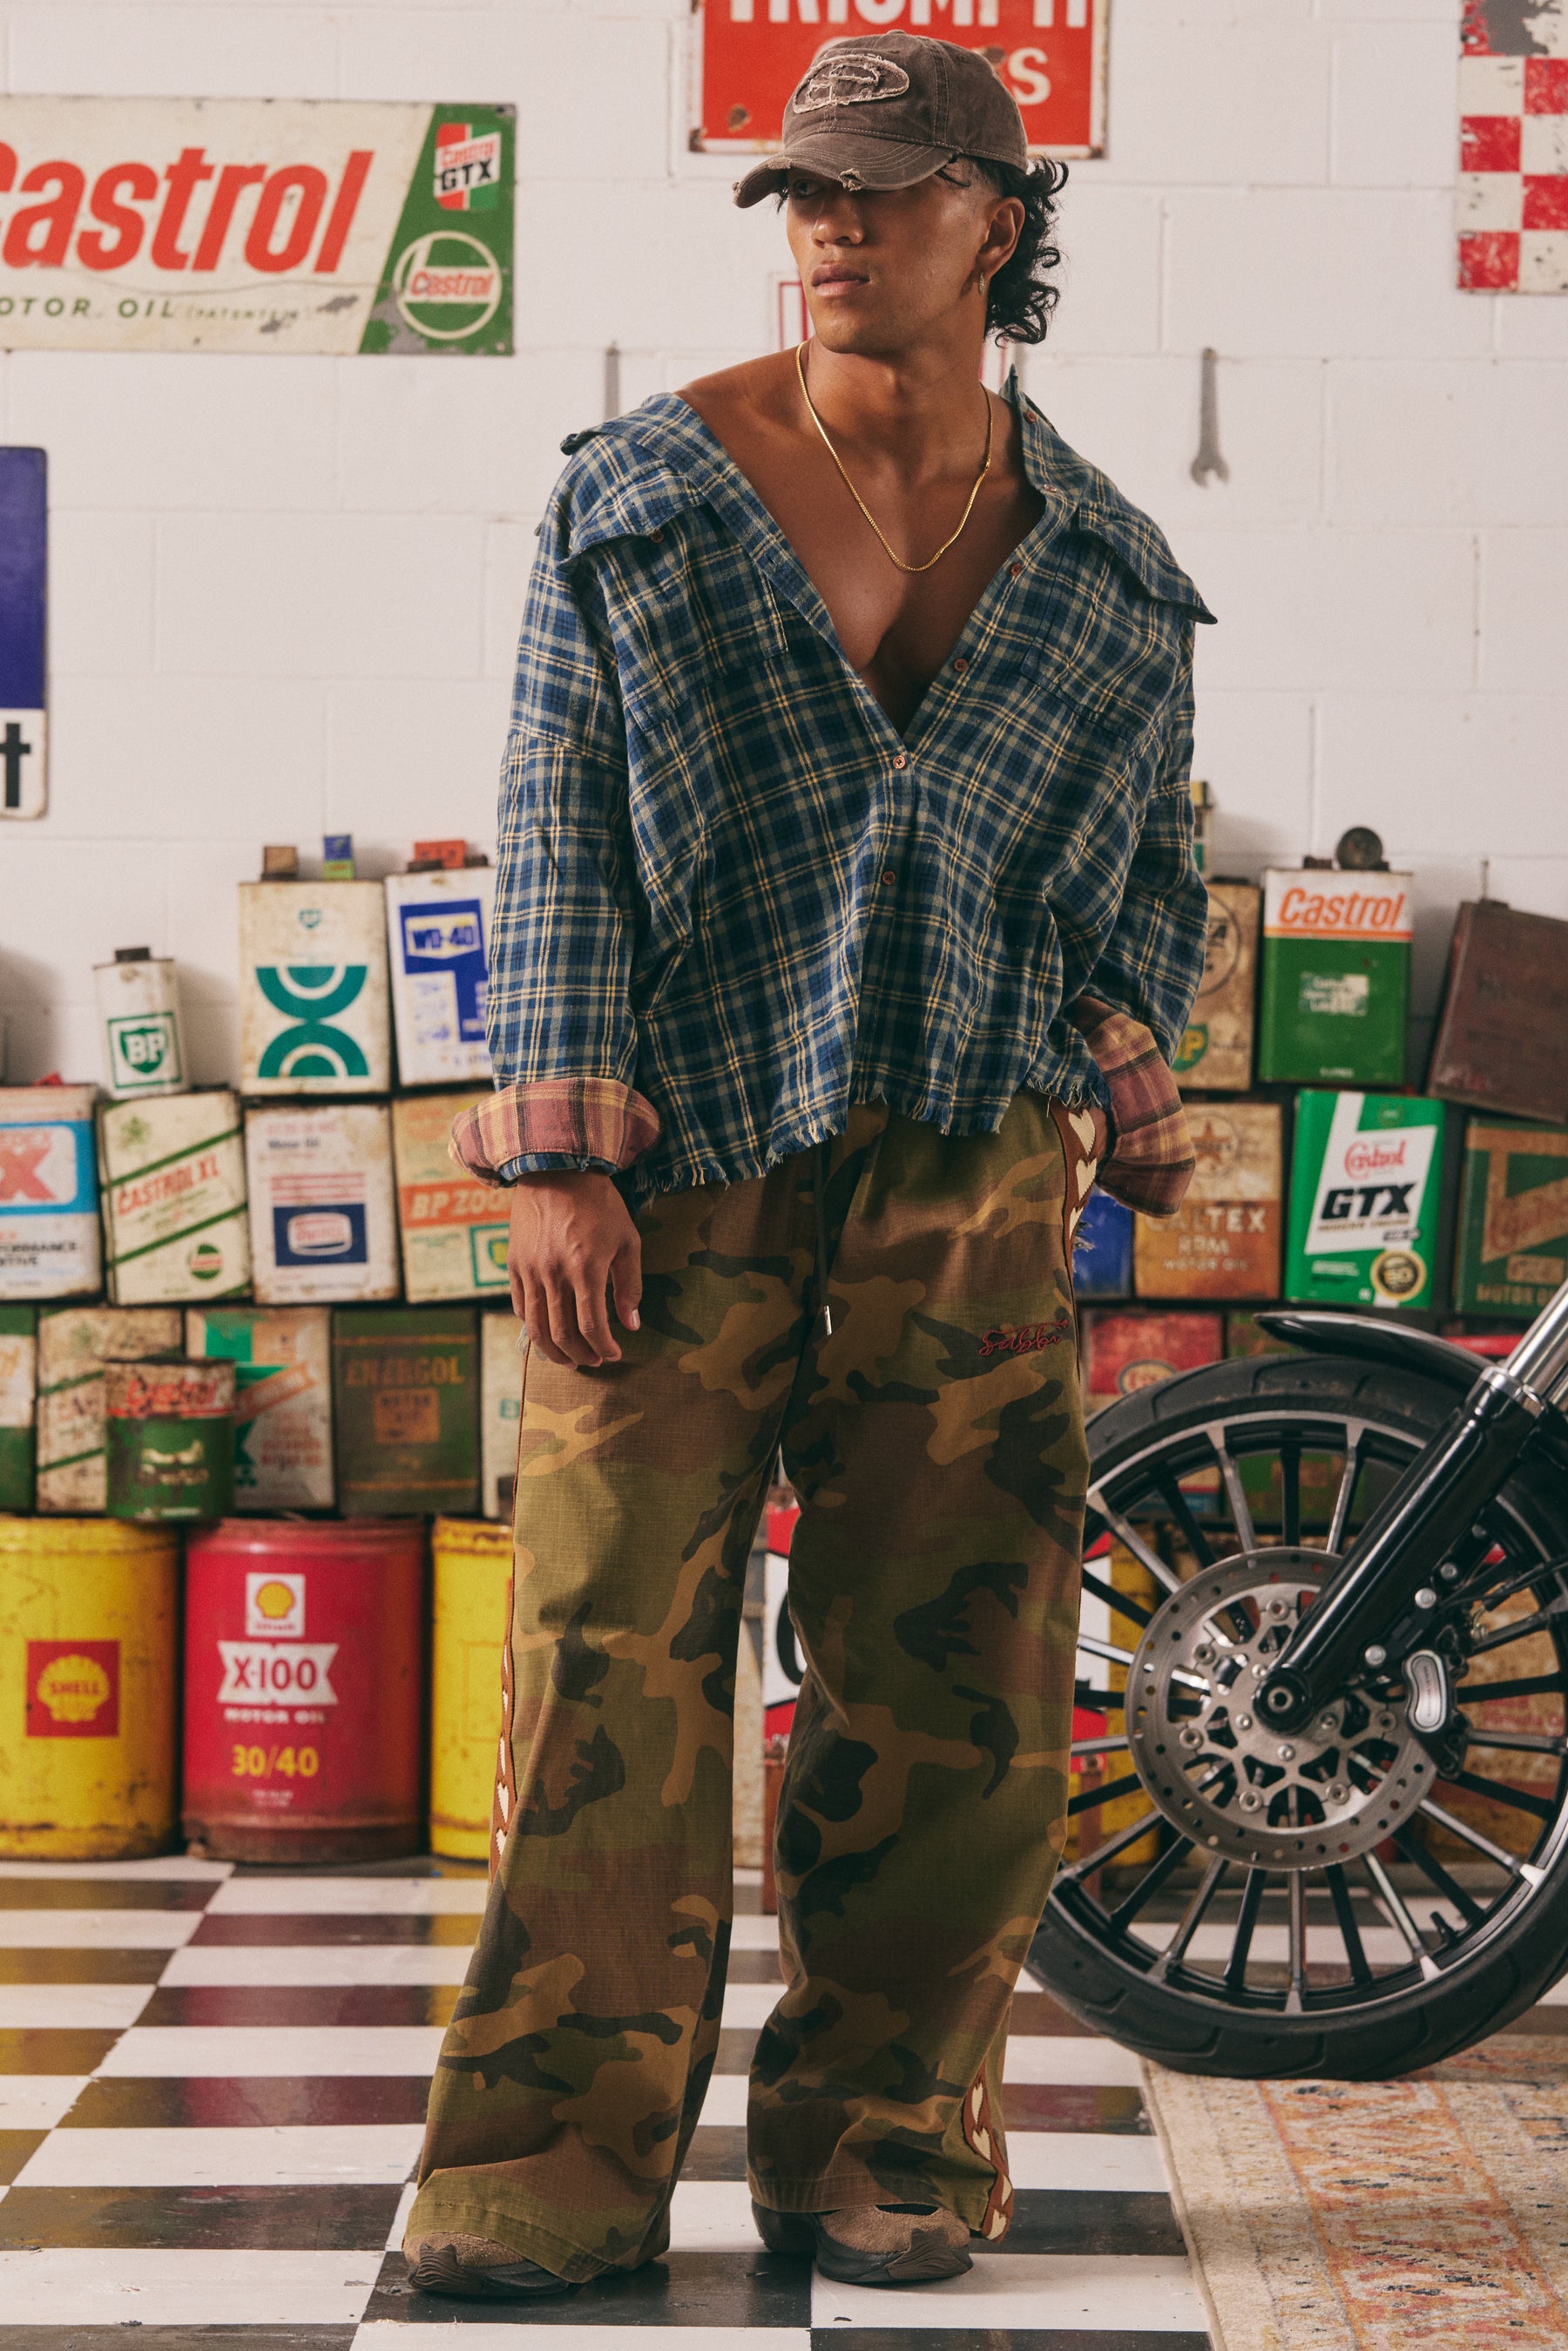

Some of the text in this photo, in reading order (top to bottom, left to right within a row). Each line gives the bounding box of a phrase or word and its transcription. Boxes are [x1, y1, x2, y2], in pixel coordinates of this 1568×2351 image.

[441, 159, 492, 191] GTX
[0, 141, 375, 274] astrol
[410, 271, 495, 297] Castrol
[118, 298, 173, 318] OIL
[1278, 887, 1406, 927] Castrol
[412, 925, 475, 950] WD-40
[124, 1031, 167, 1065] BP
[1344, 1139, 1407, 1181] Castrol
[117, 1165, 193, 1216] CASTROL
[410, 1193, 449, 1219] BP
[1321, 1183, 1417, 1220] GTX
[345, 1356, 464, 1386] ENERGOL
[49, 1680, 99, 1695] SHELL
[223, 1708, 290, 1725] MOTOR
[231, 1744, 320, 1778] 30/40
